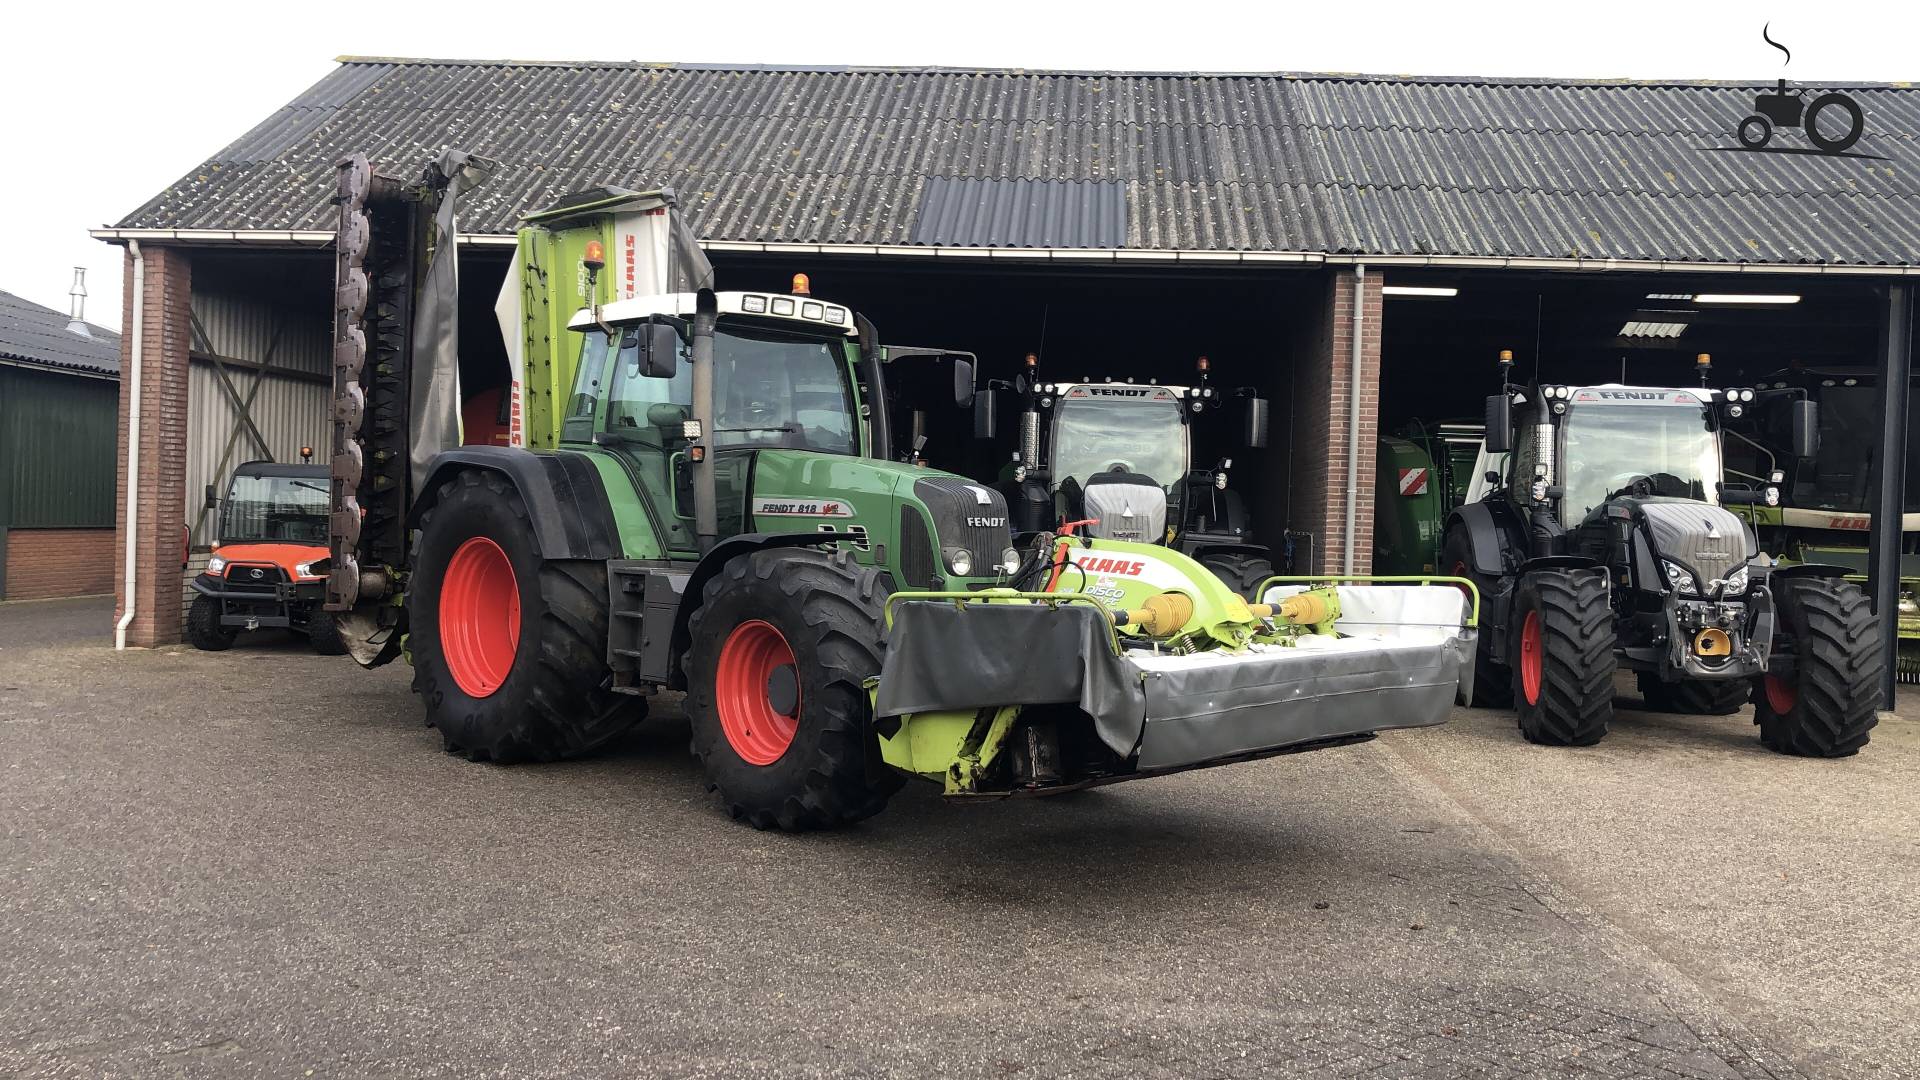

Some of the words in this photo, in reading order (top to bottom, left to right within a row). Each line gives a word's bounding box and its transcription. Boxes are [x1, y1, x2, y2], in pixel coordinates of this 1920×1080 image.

[625, 234, 635, 300] CLAAS
[1089, 388, 1151, 397] FENDT
[1598, 391, 1669, 400] FENDT
[511, 380, 522, 446] CLAAS
[761, 503, 796, 514] FENDT
[797, 504, 817, 514] 818
[966, 517, 1006, 527] FENDT
[1828, 517, 1871, 529] CLA
[1074, 556, 1146, 577] CLAAS
[1085, 585, 1125, 599] DISCO
